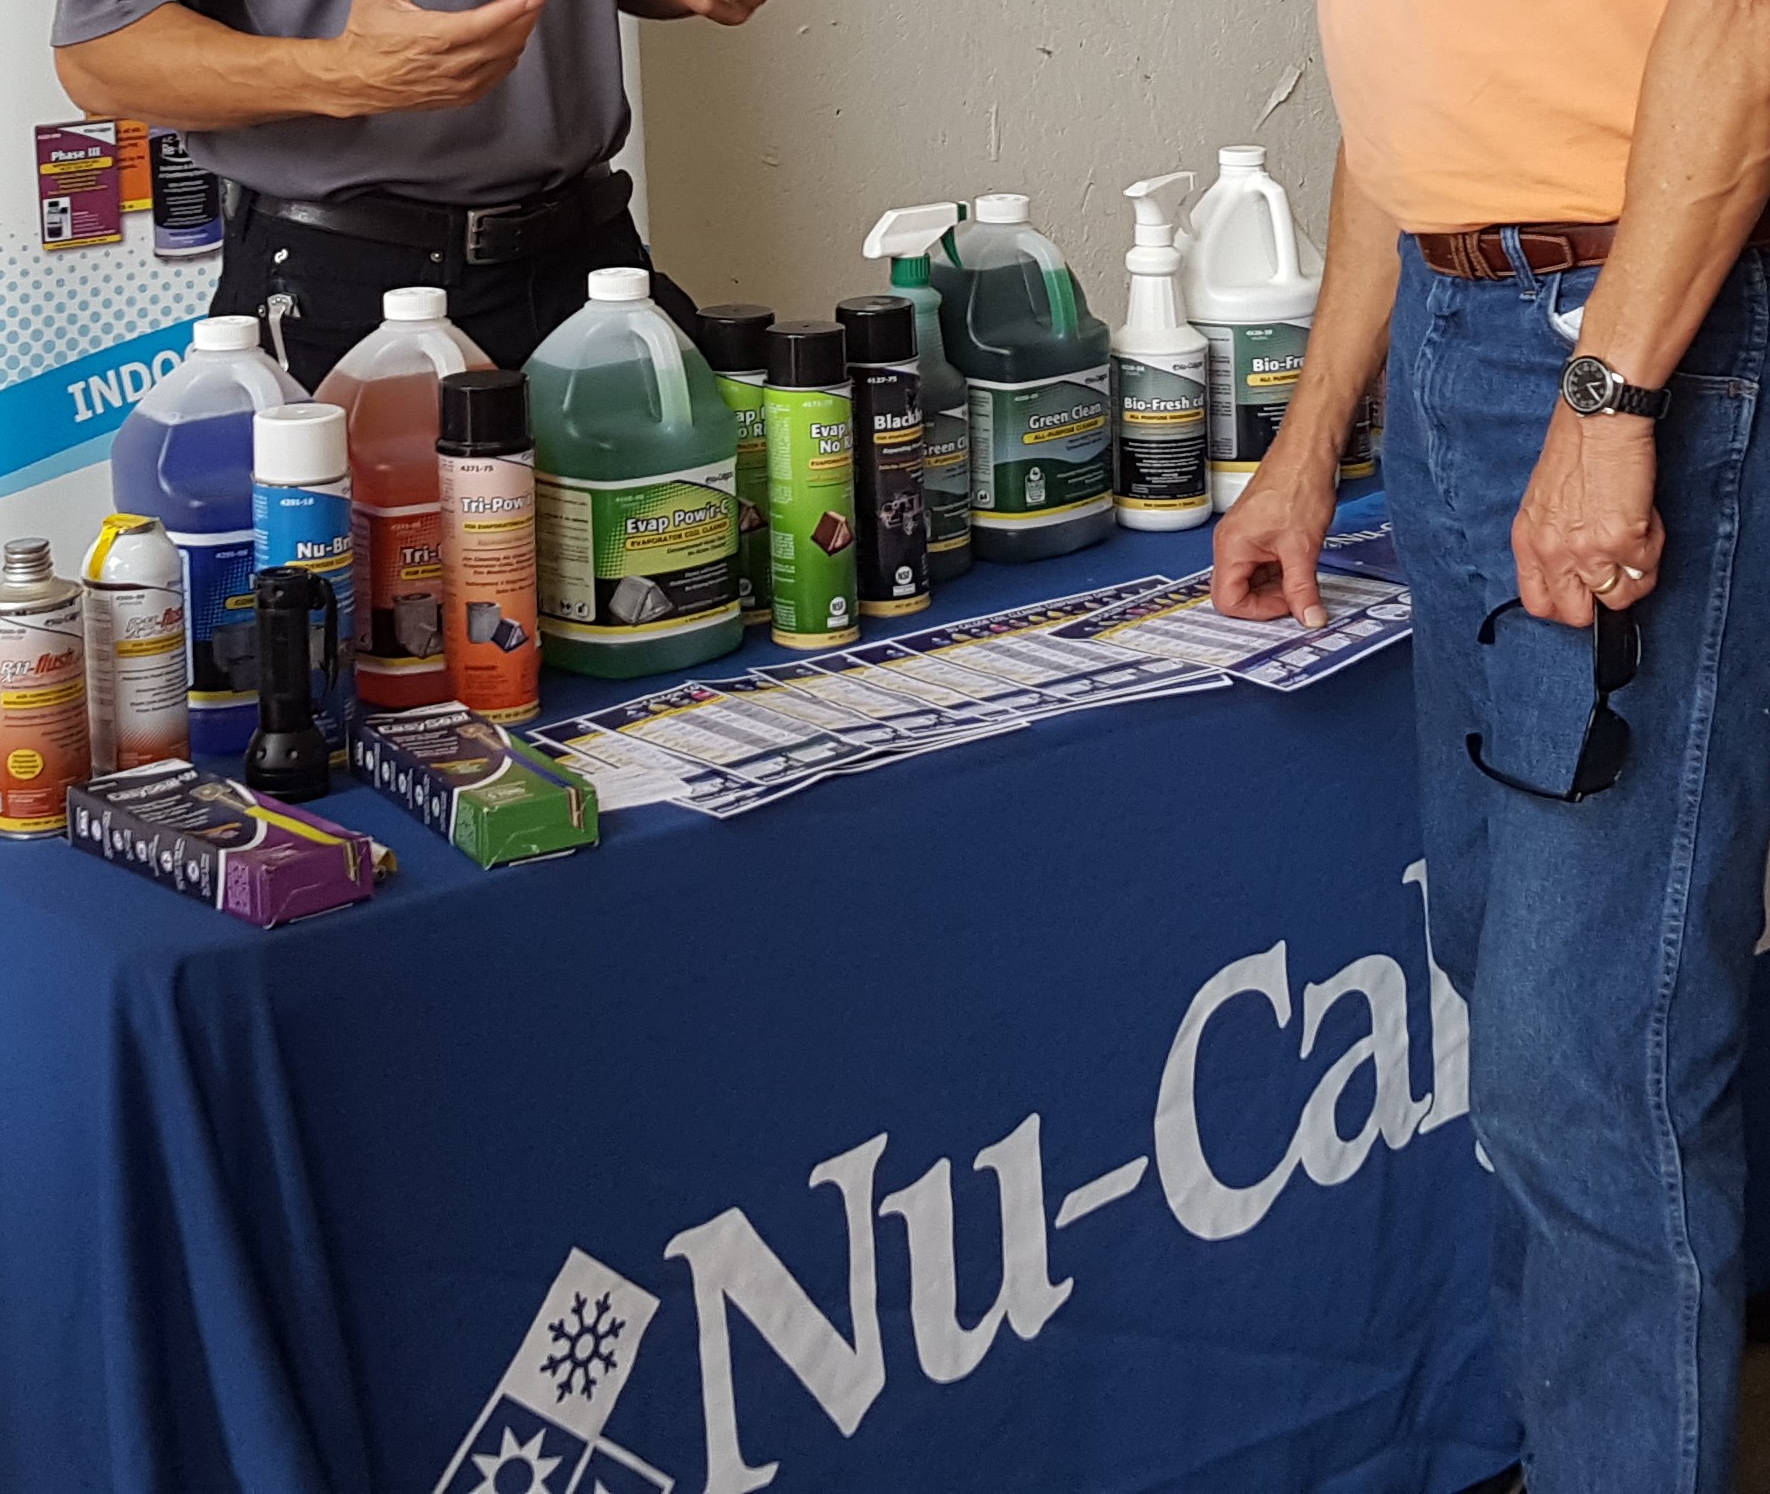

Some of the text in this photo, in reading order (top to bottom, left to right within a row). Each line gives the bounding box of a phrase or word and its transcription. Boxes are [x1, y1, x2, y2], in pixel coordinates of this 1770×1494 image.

[51, 147, 101, 161] Phase III
[67, 342, 193, 424] INDO
[1123, 396, 1190, 411] Bio-Fresh
[1029, 402, 1102, 430] Green Clean
[810, 423, 846, 439] Evap
[819, 440, 841, 454] No
[625, 515, 669, 534] Evap
[630, 532, 683, 547] EVAPORATOR
[684, 529, 700, 538] COIL
